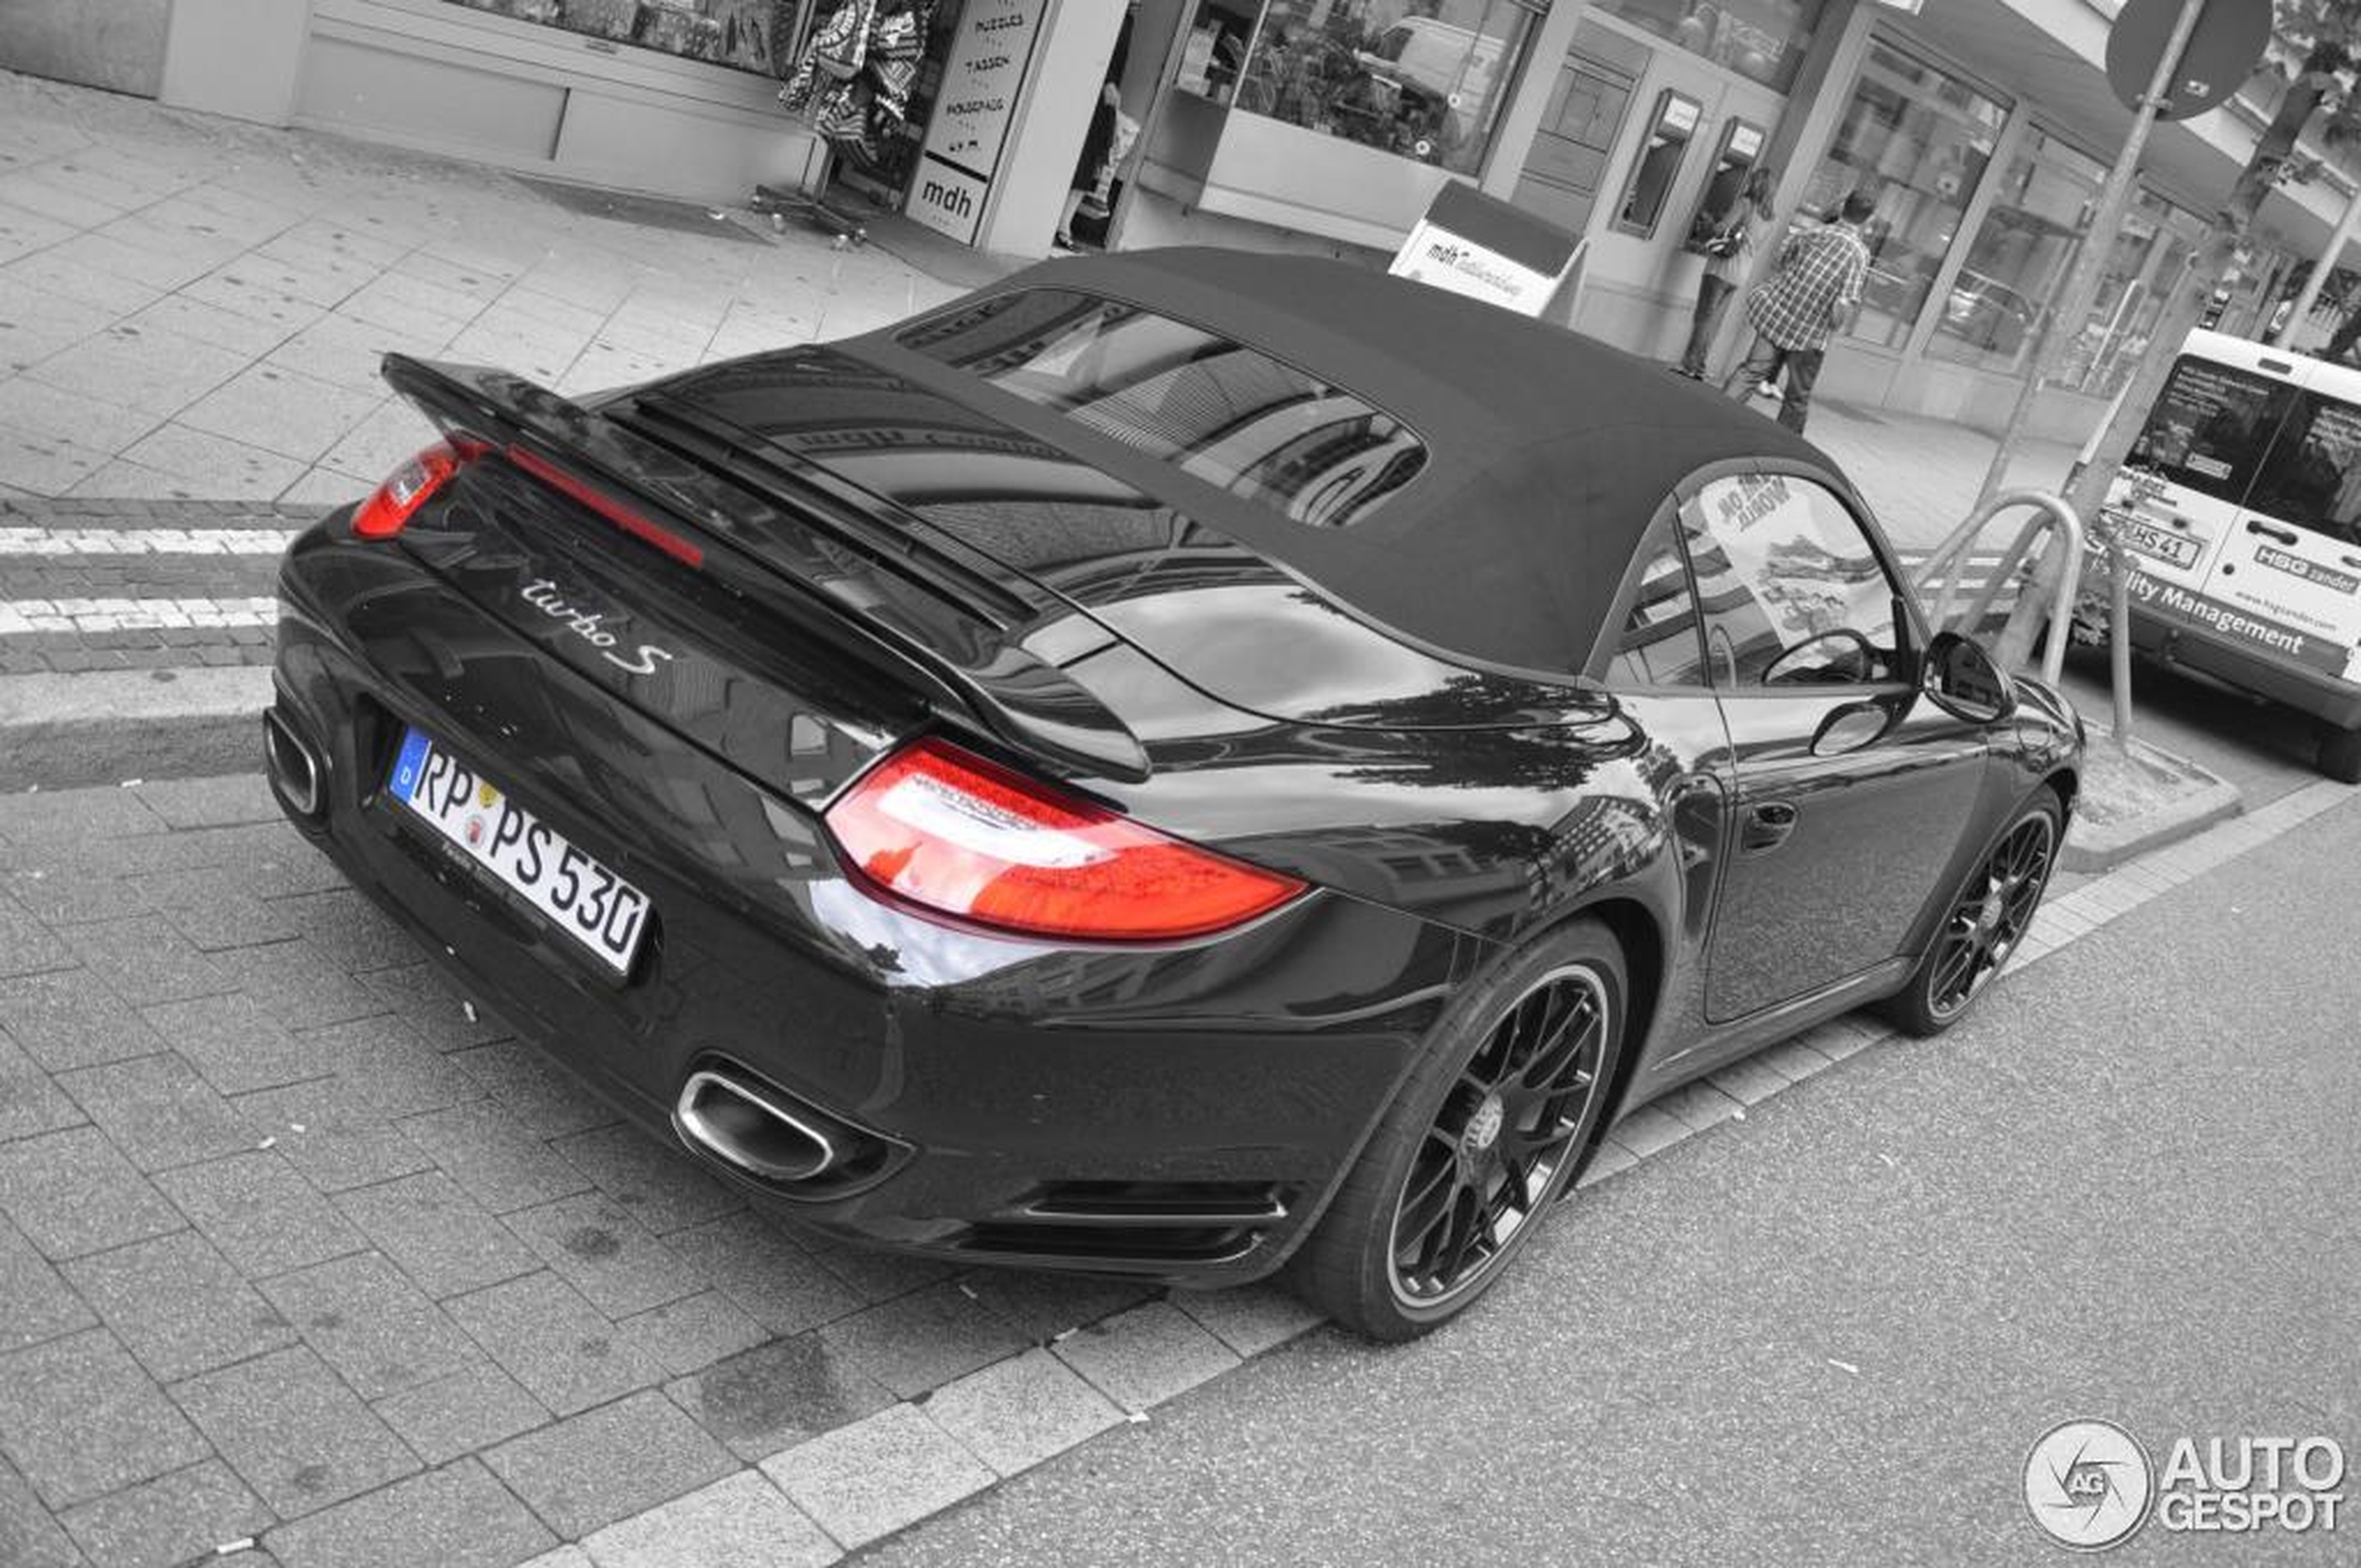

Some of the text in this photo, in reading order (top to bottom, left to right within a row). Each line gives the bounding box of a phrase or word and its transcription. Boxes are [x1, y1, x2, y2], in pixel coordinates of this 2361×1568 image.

[921, 180, 971, 219] mdh
[521, 578, 673, 674] turbo S
[2160, 586, 2303, 654] Management
[415, 744, 642, 955] RP PS 530
